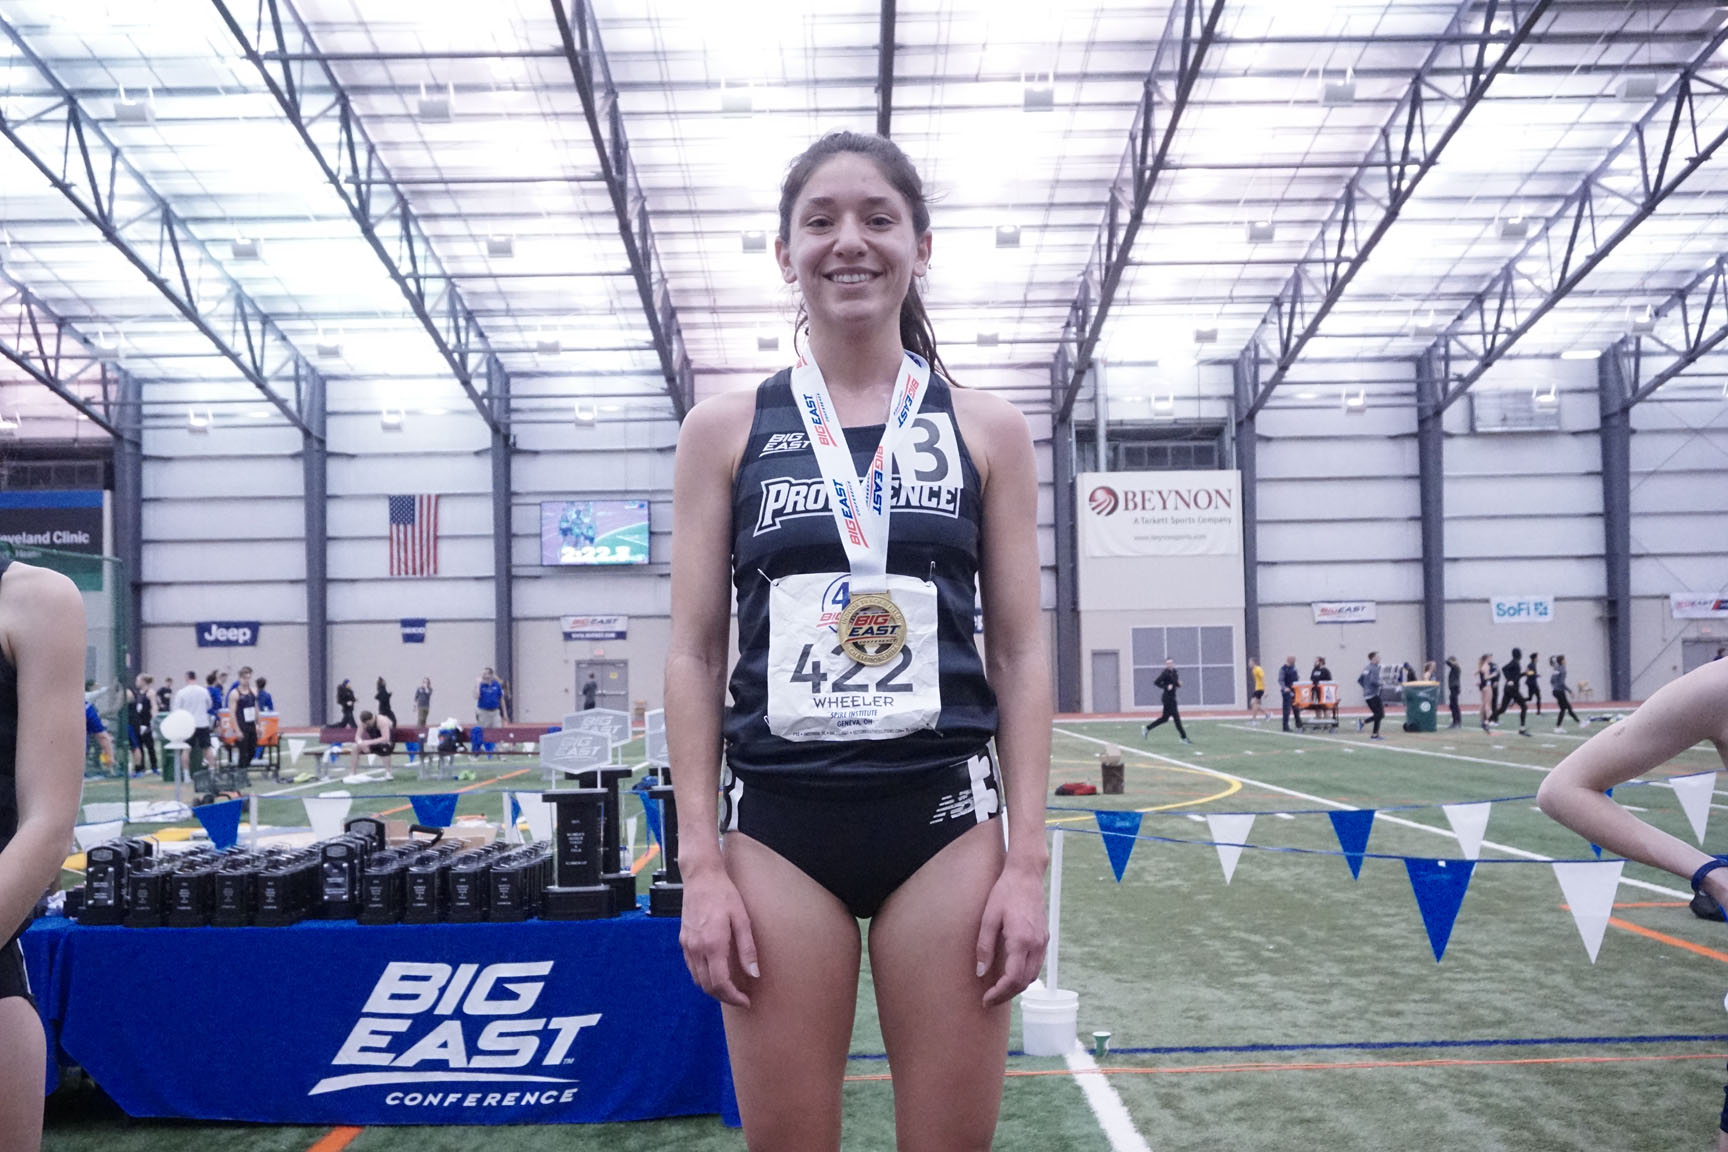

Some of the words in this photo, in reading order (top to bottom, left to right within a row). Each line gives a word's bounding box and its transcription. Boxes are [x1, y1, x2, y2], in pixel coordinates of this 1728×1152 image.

[803, 394, 823, 425] EAST
[898, 394, 913, 428] EAST
[762, 440, 811, 451] EAST
[768, 432, 806, 442] BIG
[814, 425, 830, 446] BIG
[911, 418, 949, 483] 3
[832, 479, 853, 519] EAST
[872, 470, 884, 515] EAST
[1123, 489, 1232, 511] BEYNON
[844, 519, 862, 545] BIG
[1133, 517, 1140, 525] A
[1171, 517, 1196, 527] Sports
[1198, 517, 1232, 528] Company
[53, 531, 90, 545] Clinic
[1496, 602, 1530, 617] SoFi
[849, 625, 901, 637] EAST
[854, 615, 890, 627] BIG
[204, 624, 251, 643] Jeep
[789, 644, 914, 694] 422
[813, 695, 895, 708] WHEELER
[848, 709, 878, 718] INSTITUTE
[863, 718, 873, 726] OH
[361, 960, 555, 1015] BIG
[331, 1013, 603, 1068] EAST
[385, 1087, 579, 1107] CONFERENCE
